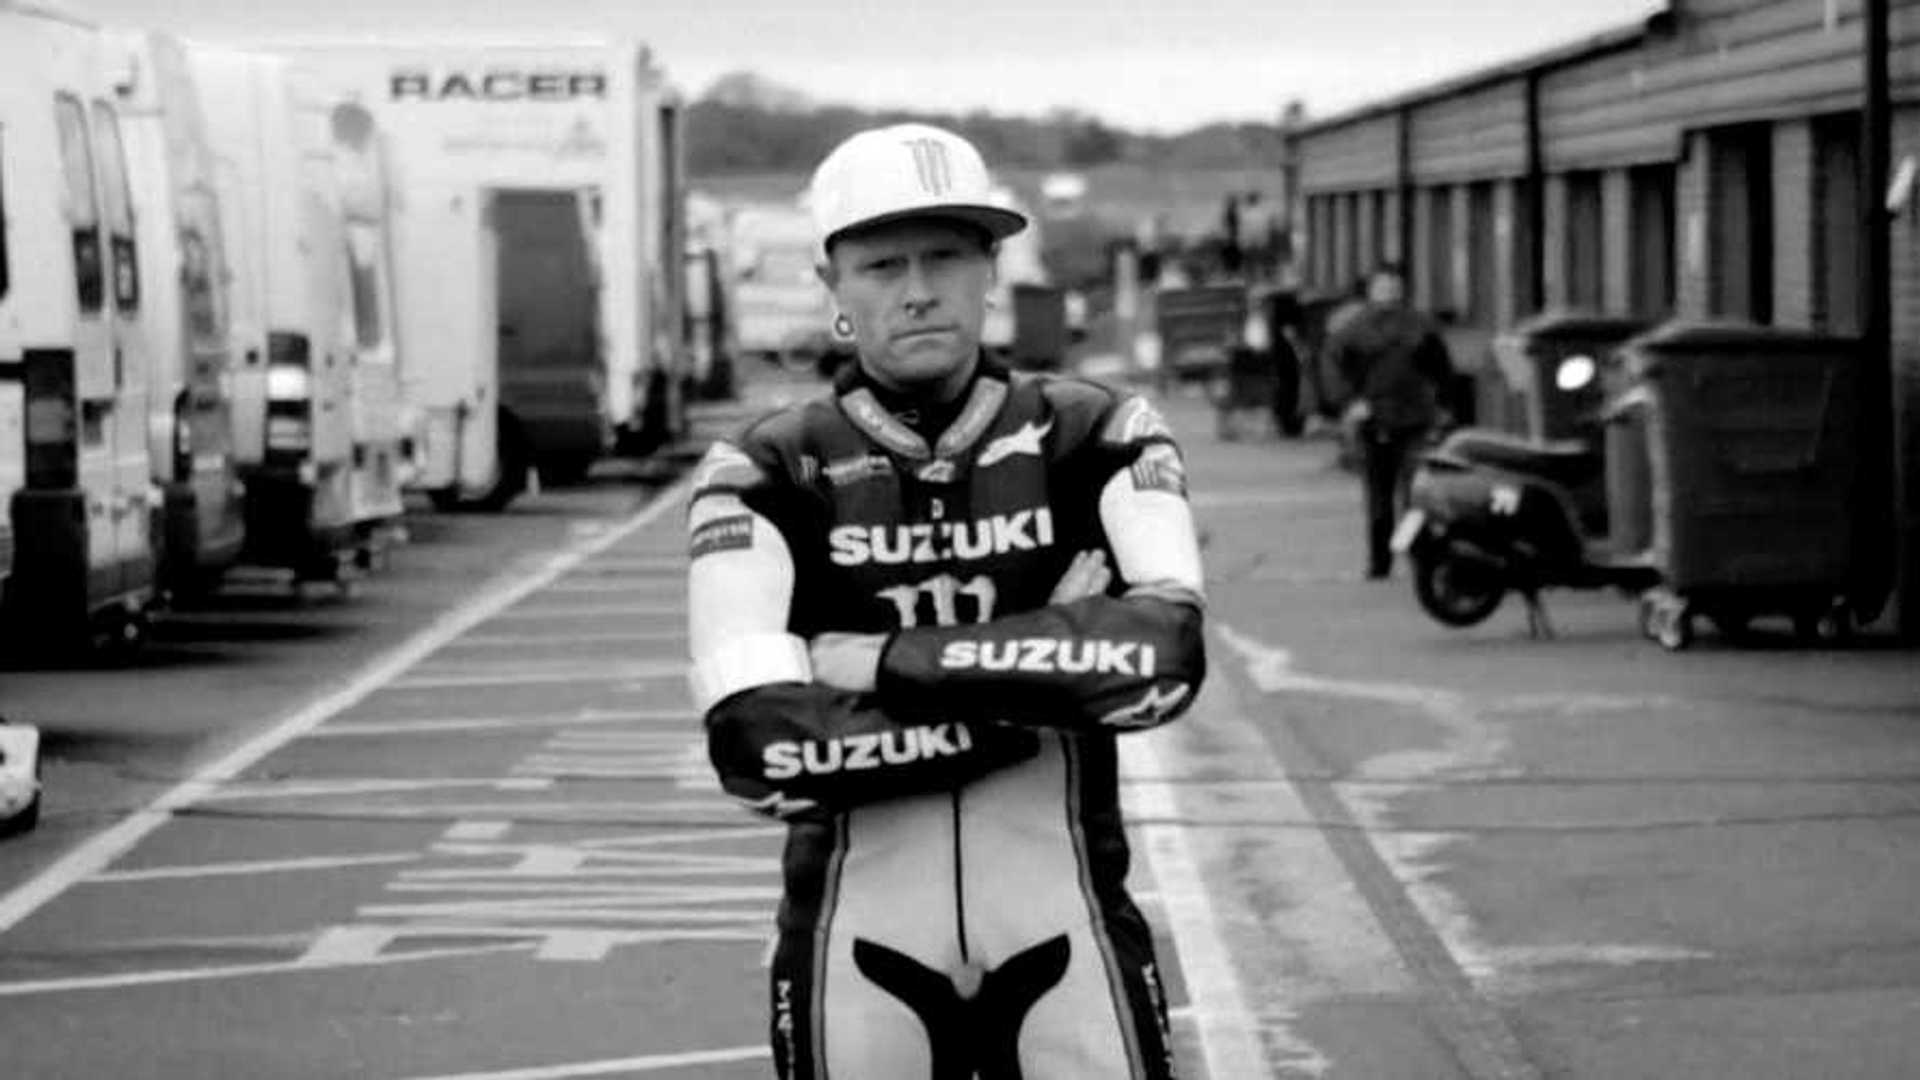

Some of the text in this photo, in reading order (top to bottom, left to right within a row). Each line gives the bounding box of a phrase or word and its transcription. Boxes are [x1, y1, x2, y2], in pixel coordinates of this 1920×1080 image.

[389, 73, 607, 101] RACER
[829, 506, 1054, 566] SUZUKI
[940, 637, 1156, 678] SUZUKI
[762, 722, 972, 779] SUZUKI
